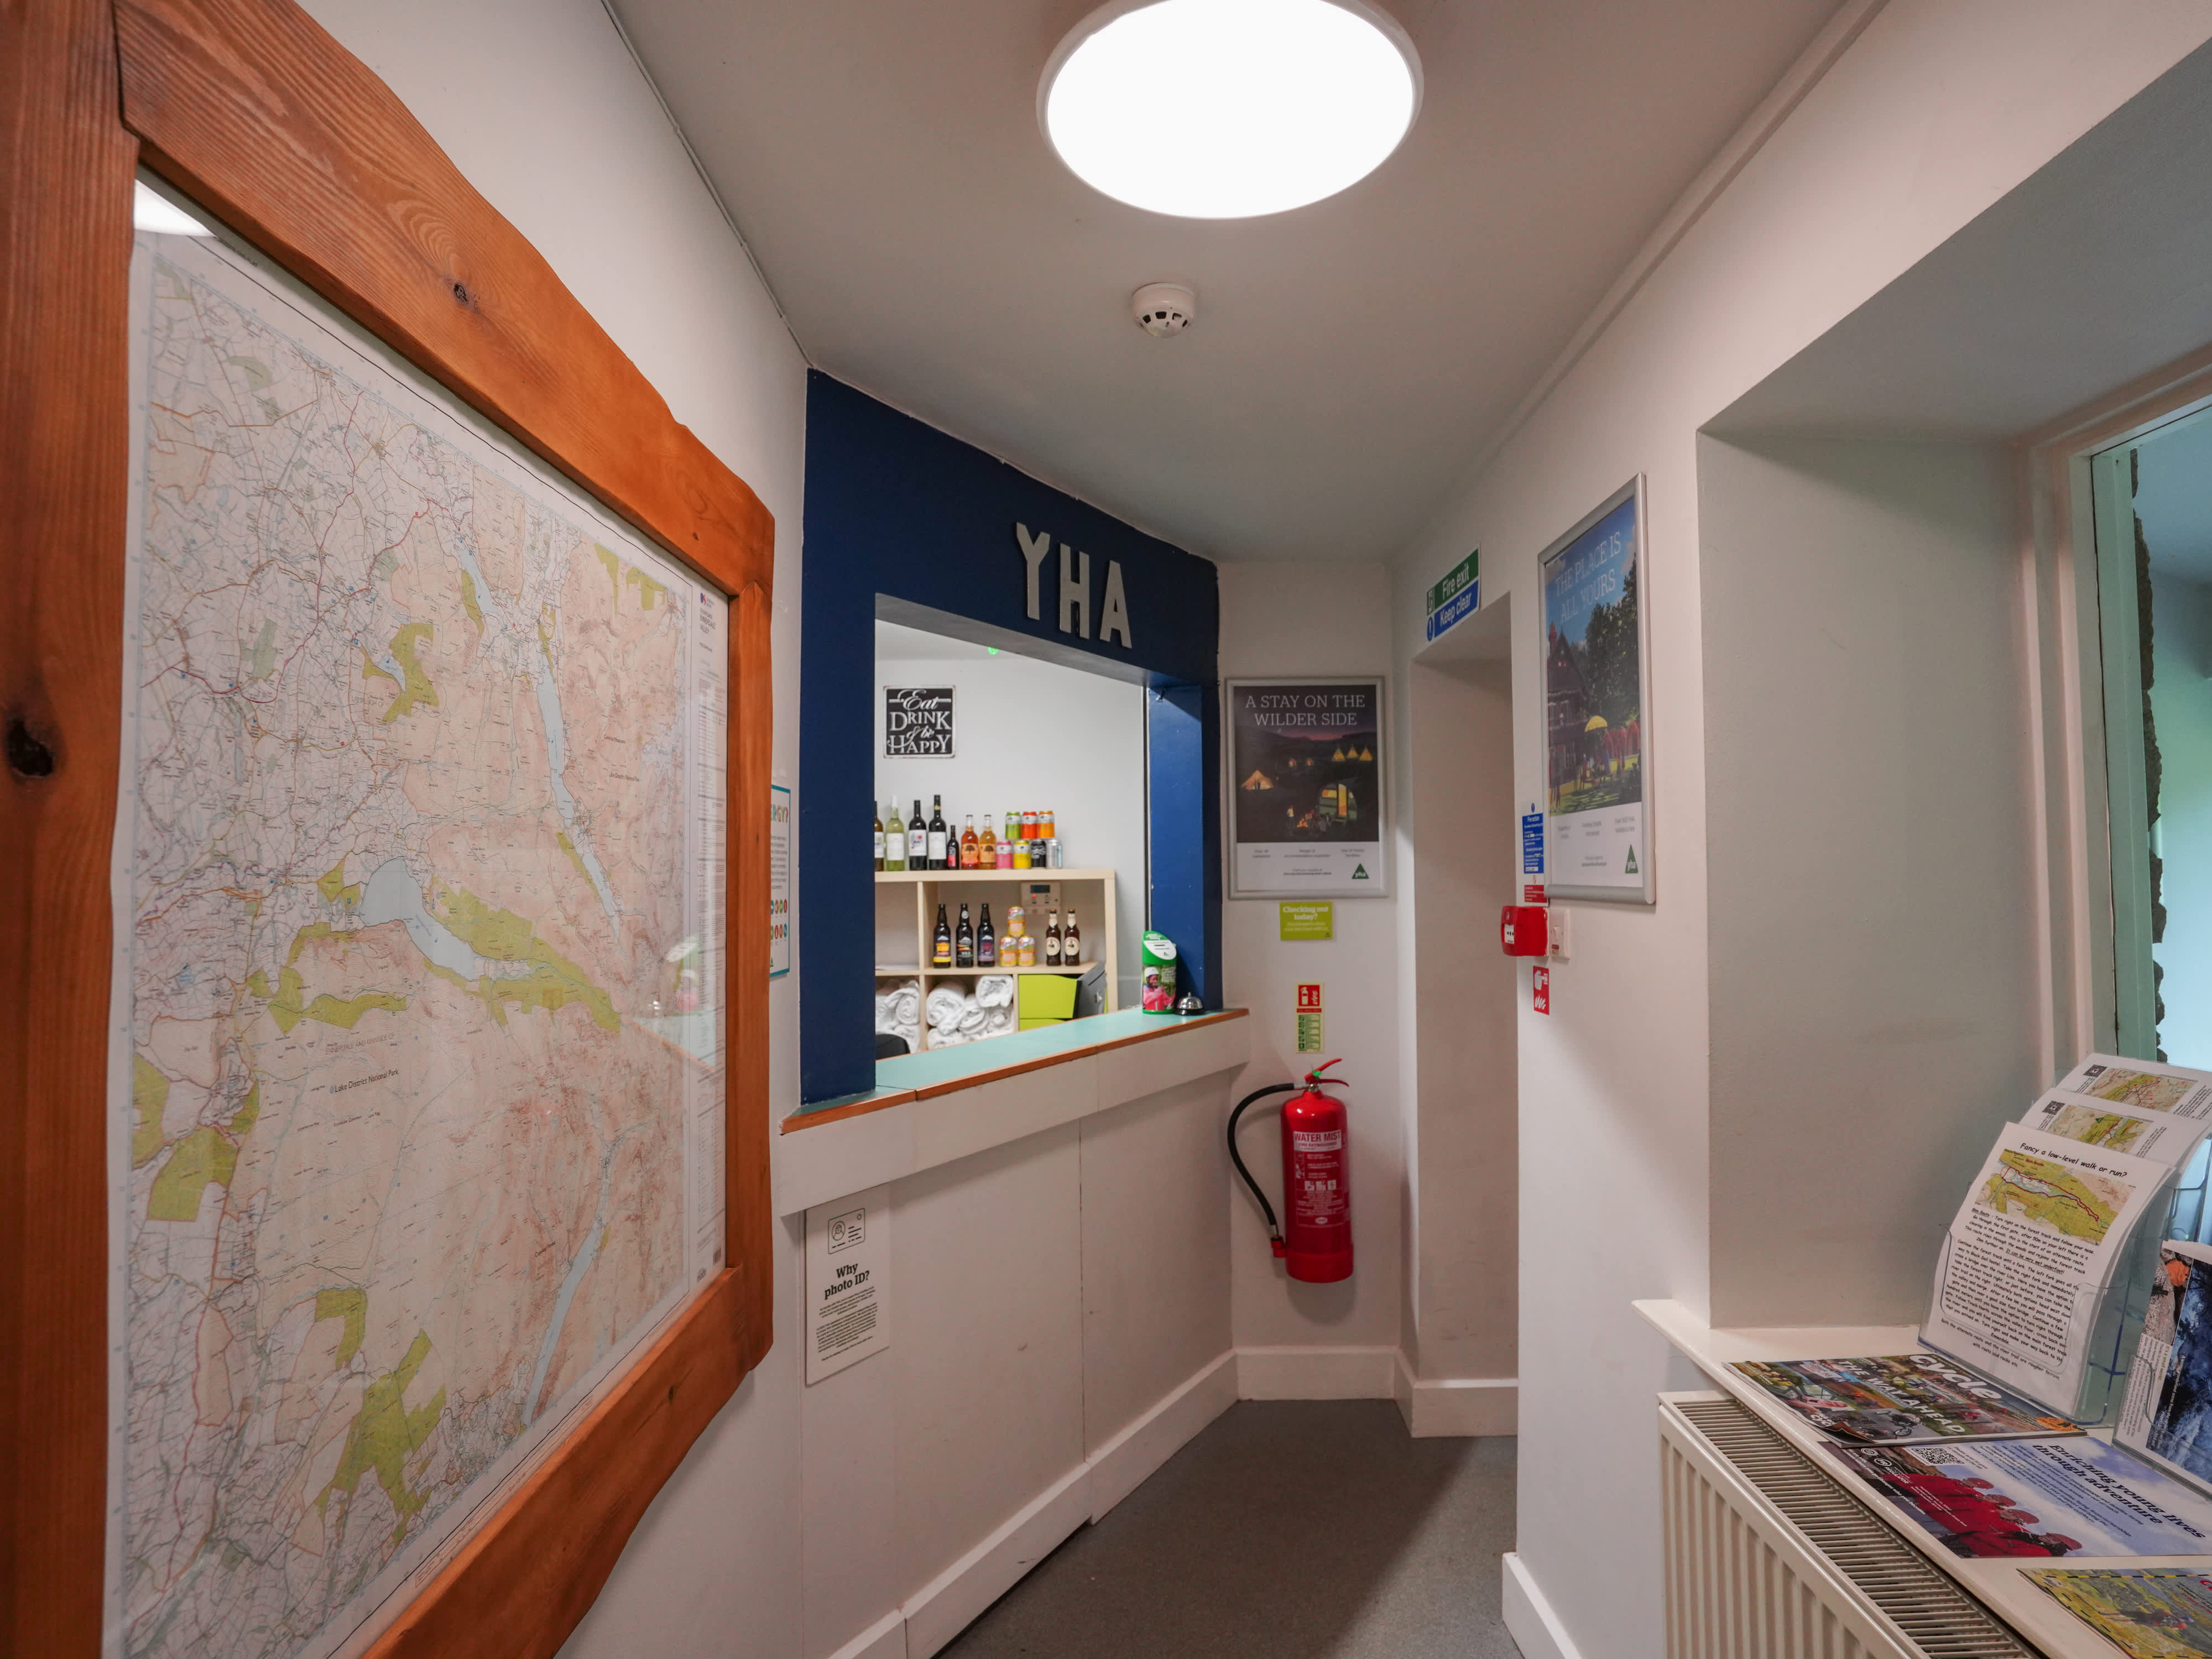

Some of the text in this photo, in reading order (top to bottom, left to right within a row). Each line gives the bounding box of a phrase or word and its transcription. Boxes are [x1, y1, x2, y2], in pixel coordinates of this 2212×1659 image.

[1555, 531, 1621, 597] THE PLACE IS
[1016, 521, 1133, 649] YHA
[1442, 564, 1469, 600] Fire exit
[1560, 570, 1615, 623] ALL YOURS
[1440, 592, 1472, 628] Keep clear
[898, 689, 940, 711] Eat
[1245, 695, 1365, 708] A STAY ON THE
[889, 711, 951, 731] DRINK
[1254, 712, 1358, 726] WILDER SIDE
[920, 726, 935, 738] be
[889, 734, 951, 753] HAPPY
[771, 804, 788, 823] RGY?
[1627, 860, 1636, 871] yha
[335, 1084, 347, 1093] Lake
[348, 1078, 367, 1089] District
[368, 1072, 387, 1083] National
[1294, 1131, 1341, 1142] WATER MIST
[2020, 1143, 2039, 1154] Fancy
[2048, 1151, 2079, 1164] low-level
[2052, 1253, 2071, 1261] alternate
[836, 1263, 858, 1279] Why
[2043, 1264, 2064, 1273] underfoot!
[824, 1270, 870, 1300] photo ID?
[2051, 1284, 2074, 1296] immediately
[1838, 1361, 1965, 1432] THE WAY AHEAD
[2032, 1445, 2163, 1524] through adventure
[2049, 1445, 2206, 1538] Enriching young lives
